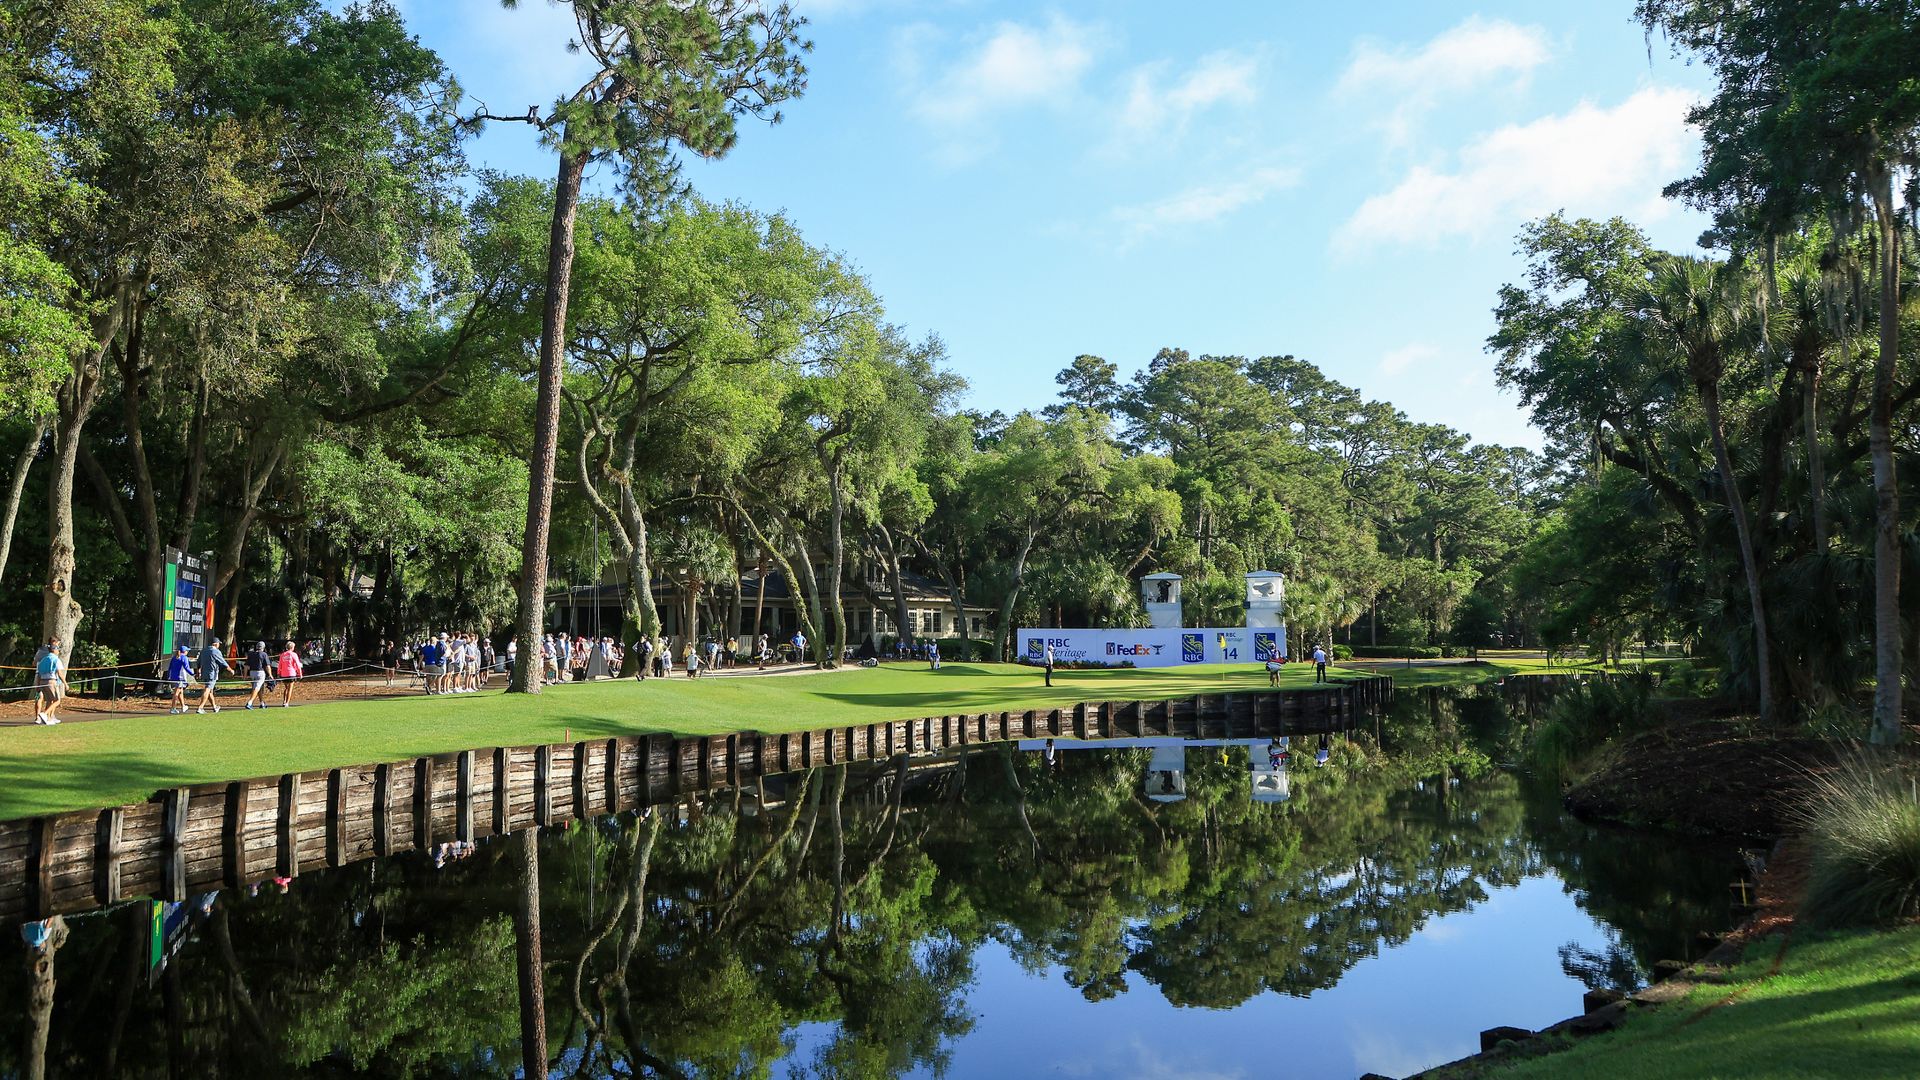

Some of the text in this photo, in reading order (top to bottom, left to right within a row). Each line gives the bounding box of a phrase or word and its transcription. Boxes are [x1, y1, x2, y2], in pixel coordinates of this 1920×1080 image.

[1048, 638, 1070, 648] RBC
[1117, 644, 1150, 655] FedEx
[1222, 647, 1238, 660] 14
[1184, 653, 1203, 661] RBC
